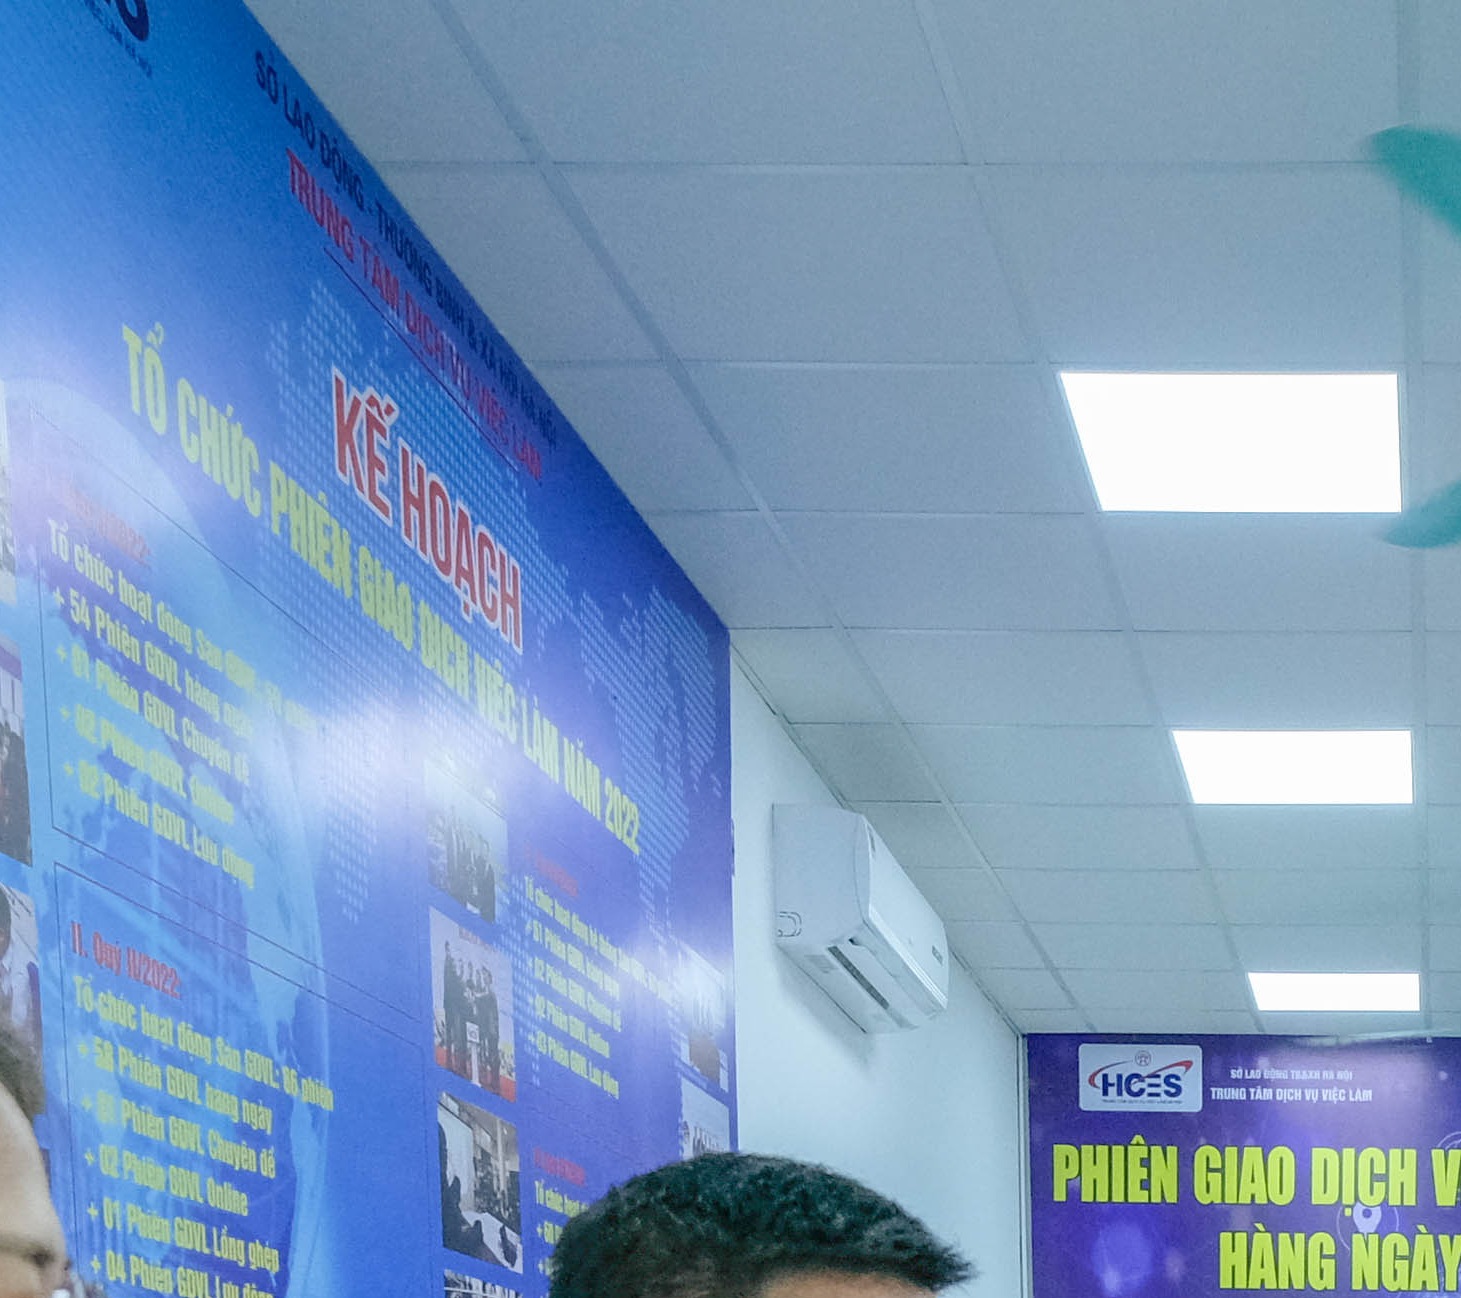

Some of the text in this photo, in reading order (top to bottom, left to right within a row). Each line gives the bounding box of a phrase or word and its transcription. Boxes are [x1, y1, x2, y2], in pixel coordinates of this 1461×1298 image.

[283, 83, 316, 150] LAO
[333, 366, 524, 655] KẾ HOẠCH
[122, 321, 168, 436] TỔ
[177, 377, 262, 518] CHỨC
[270, 460, 354, 599] PHIÊN
[358, 545, 415, 652] GIAO
[563, 736, 602, 823] NĂM
[604, 776, 641, 857] 2022
[1211, 1083, 1373, 1105] TRUNG TÂM DỊCH VỤ VIỆC LÀM
[1052, 1134, 1178, 1204] PHIÊN
[1193, 1145, 1297, 1206] GIAO
[1311, 1147, 1418, 1216] DỊCH
[127, 1203, 172, 1244] Phiên
[174, 1215, 212, 1255] GDVL
[1218, 1223, 1337, 1291] HÀNG
[130, 1255, 174, 1296] Phiên
